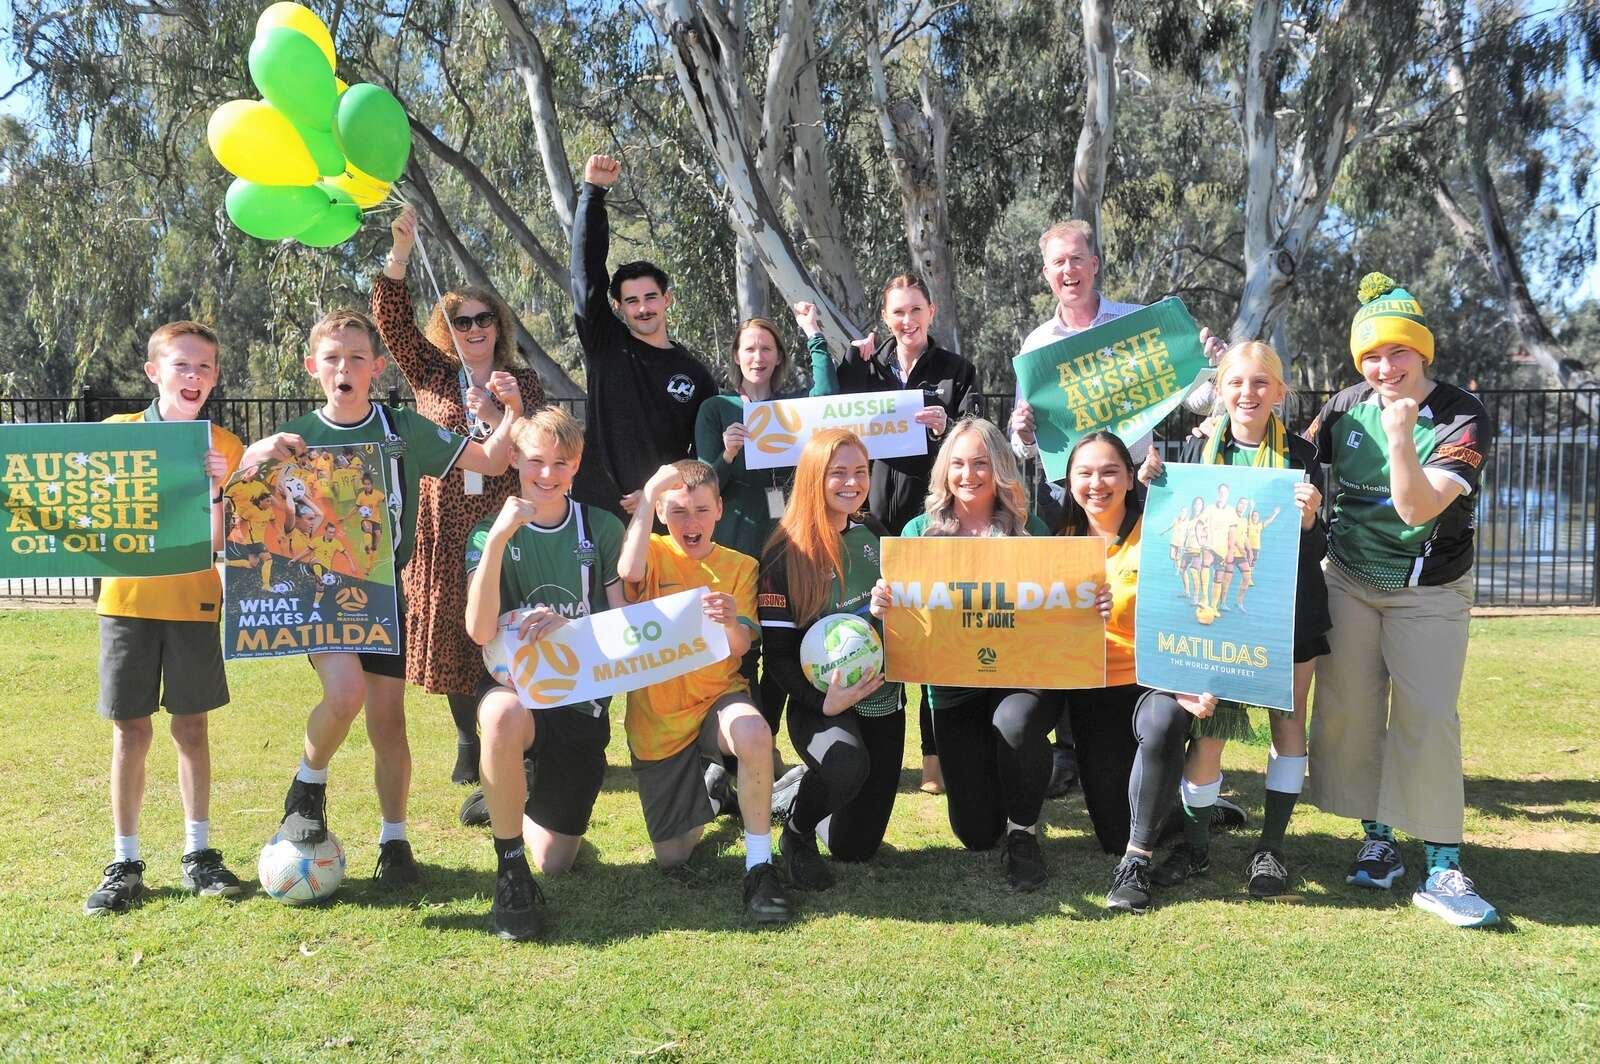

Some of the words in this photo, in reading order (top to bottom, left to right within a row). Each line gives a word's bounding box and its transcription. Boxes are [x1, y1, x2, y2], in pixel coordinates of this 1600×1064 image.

[1056, 327, 1166, 387] AUSSIE
[1064, 350, 1174, 409] AUSSIE
[822, 398, 897, 419] AUSSIE
[1073, 372, 1181, 432] AUSSIE
[812, 420, 908, 438] ILDAS
[2, 450, 158, 482] AUSSIE
[5, 478, 158, 507] AUSSIE
[1362, 484, 1390, 493] Health
[6, 503, 158, 532] AUSSIE
[11, 535, 56, 554] OI!
[63, 533, 106, 553] OI!
[113, 533, 156, 553] OI!
[239, 598, 299, 612] WHAT
[238, 612, 304, 627] MAKES
[308, 611, 322, 622] A
[962, 612, 983, 628] IT'S
[987, 612, 1015, 628] DONE
[236, 623, 392, 651] MATILDA
[623, 620, 662, 646] GO
[592, 636, 707, 682] MATILDAS
[1158, 631, 1268, 668] MATILDAS
[1170, 658, 1183, 666] THE
[1185, 661, 1209, 670] WORLD
[1237, 668, 1255, 677] FEET
